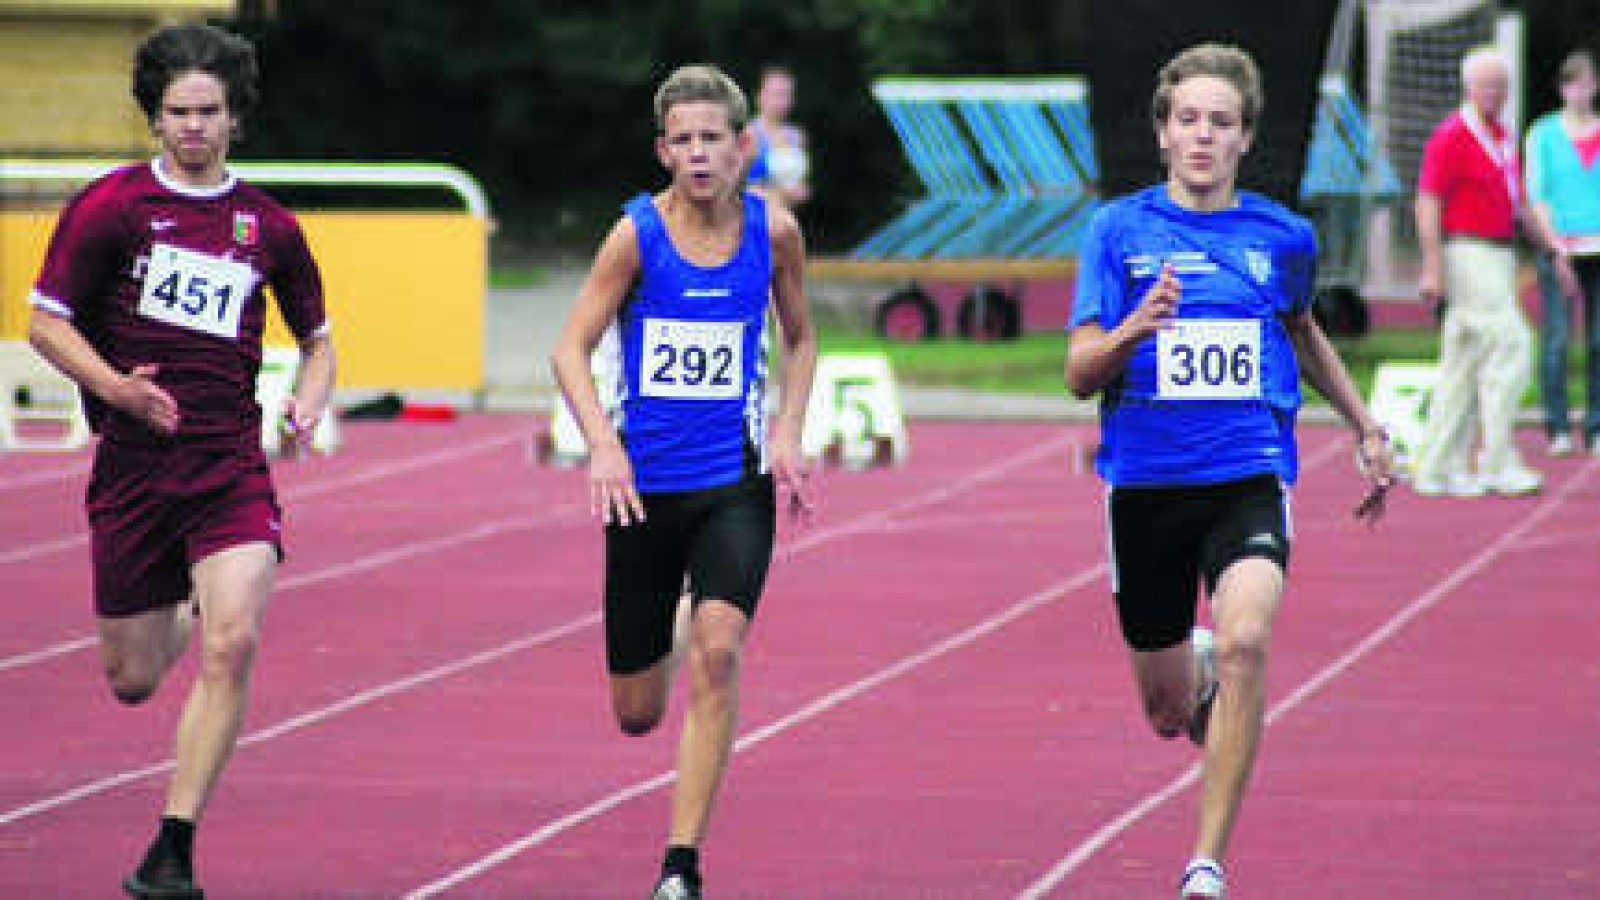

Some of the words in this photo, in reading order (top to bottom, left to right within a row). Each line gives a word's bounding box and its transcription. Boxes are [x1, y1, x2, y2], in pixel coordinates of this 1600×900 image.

[152, 270, 233, 322] 451
[650, 344, 732, 386] 292
[1171, 344, 1253, 386] 306
[833, 377, 874, 444] 5
